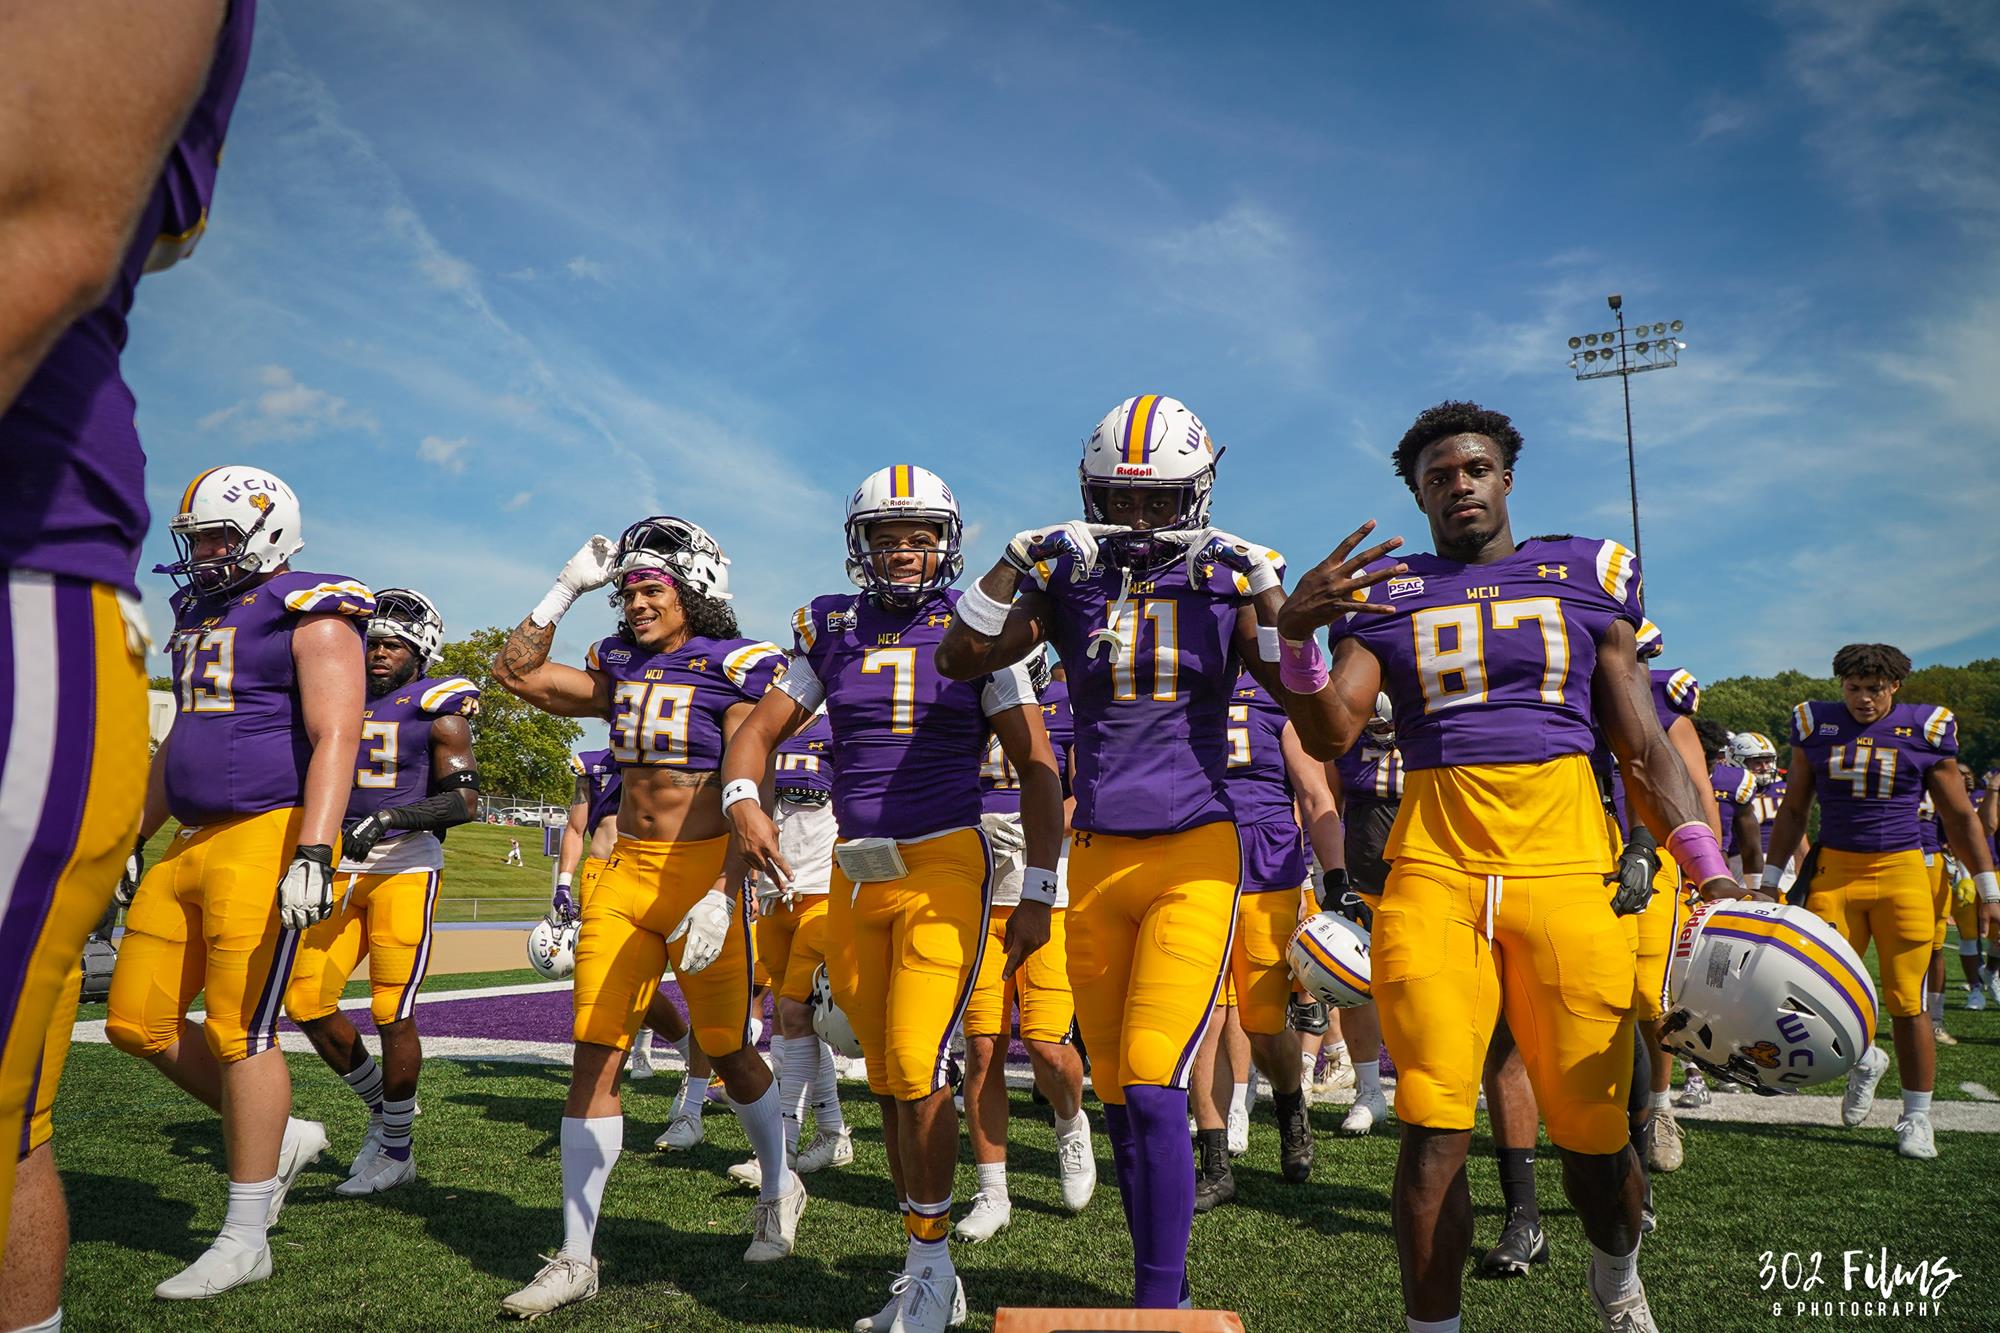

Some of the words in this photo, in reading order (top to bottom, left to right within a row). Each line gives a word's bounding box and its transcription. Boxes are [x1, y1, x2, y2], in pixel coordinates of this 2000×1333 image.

[1186, 415, 1204, 450] WC
[1116, 466, 1152, 477] Riddell
[222, 478, 278, 503] WCU
[1129, 581, 1156, 594] WCU
[1389, 581, 1422, 594] PSAC
[1466, 586, 1500, 599] WCU
[878, 633, 900, 645] WCU
[1106, 599, 1179, 702] 11
[173, 627, 237, 712] 73
[608, 653, 630, 661] PSAC
[1411, 597, 1571, 715] 87
[644, 669, 664, 680] WCU
[861, 647, 917, 734] 7
[609, 680, 696, 765] 38
[356, 720, 400, 789] 3
[1856, 737, 1874, 746] WCU
[1829, 745, 1898, 800] 41
[1675, 899, 1721, 958] Riddell
[540, 938, 554, 970] WCU
[1776, 1013, 1814, 1084] WCU
